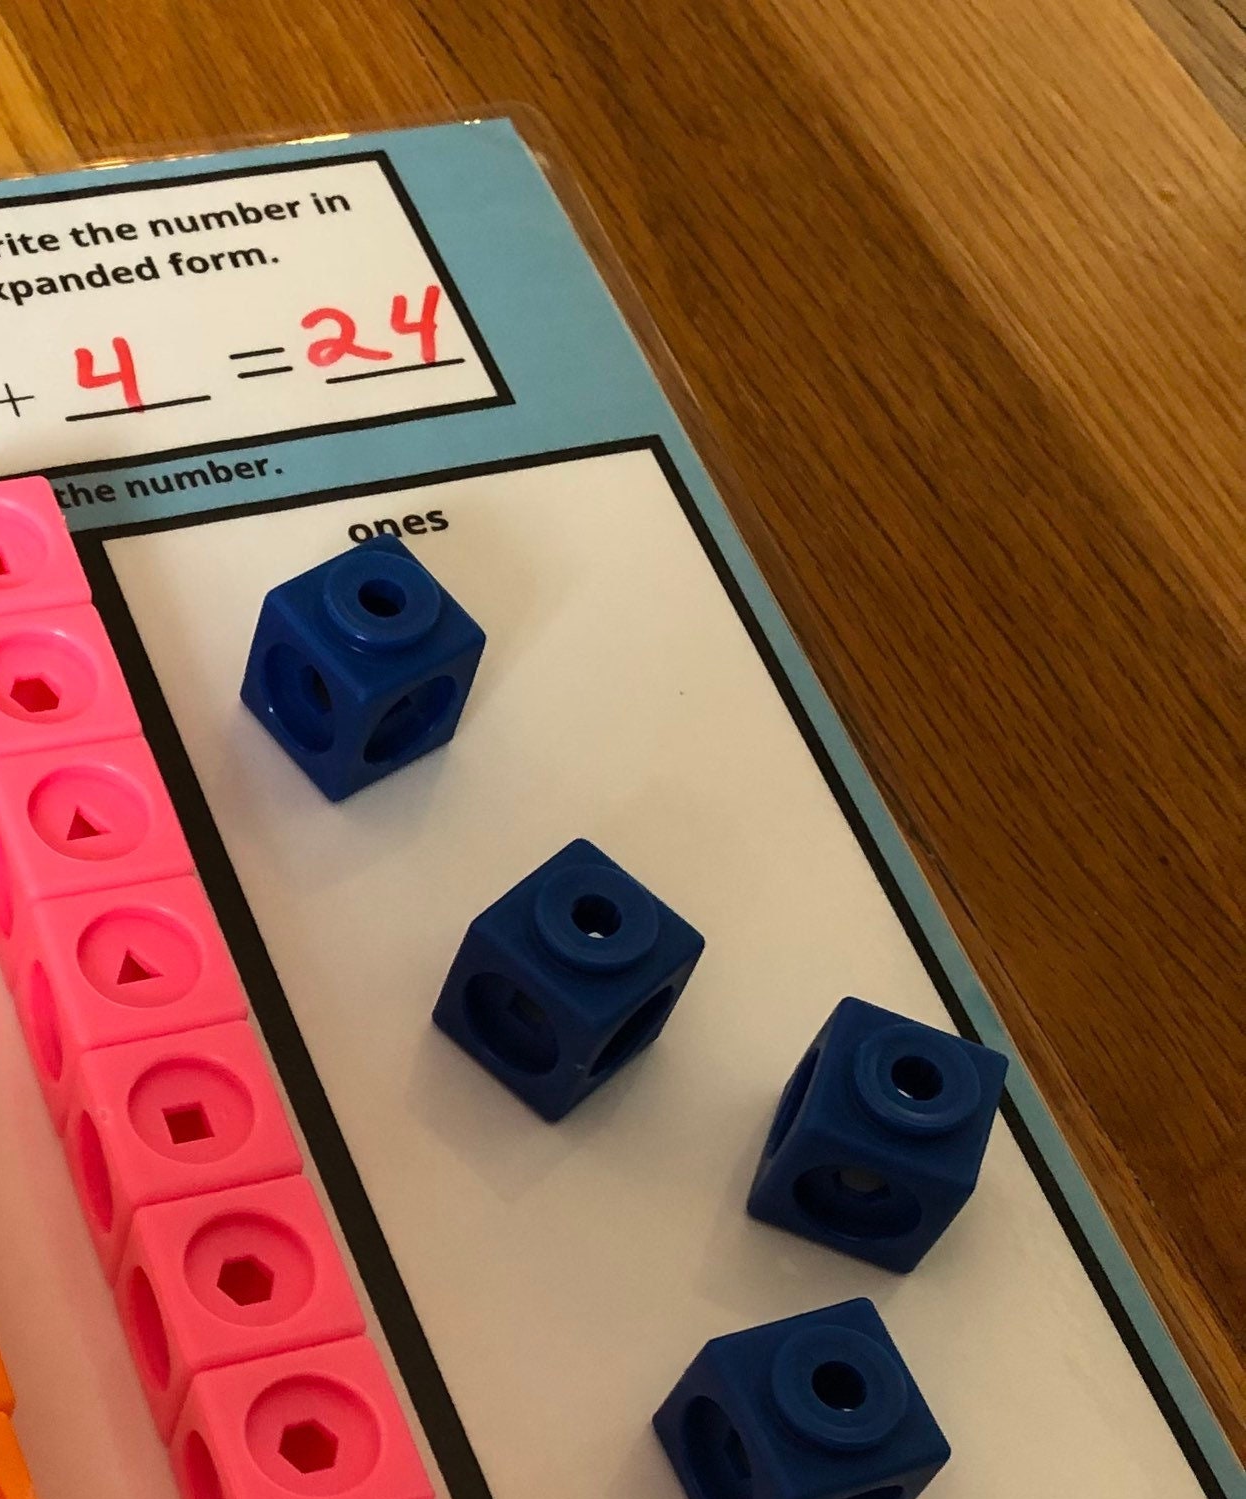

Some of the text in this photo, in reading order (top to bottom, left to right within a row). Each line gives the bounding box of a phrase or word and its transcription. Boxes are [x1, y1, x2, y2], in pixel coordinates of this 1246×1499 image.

[69, 222, 139, 248] the
[148, 200, 301, 238] number
[311, 192, 351, 215] in
[168, 248, 279, 277] form.
[74, 336, 144, 412] 4
[300, 284, 441, 368] 24
[54, 481, 118, 510] the
[125, 458, 285, 500] number.
[348, 509, 450, 544] ones
